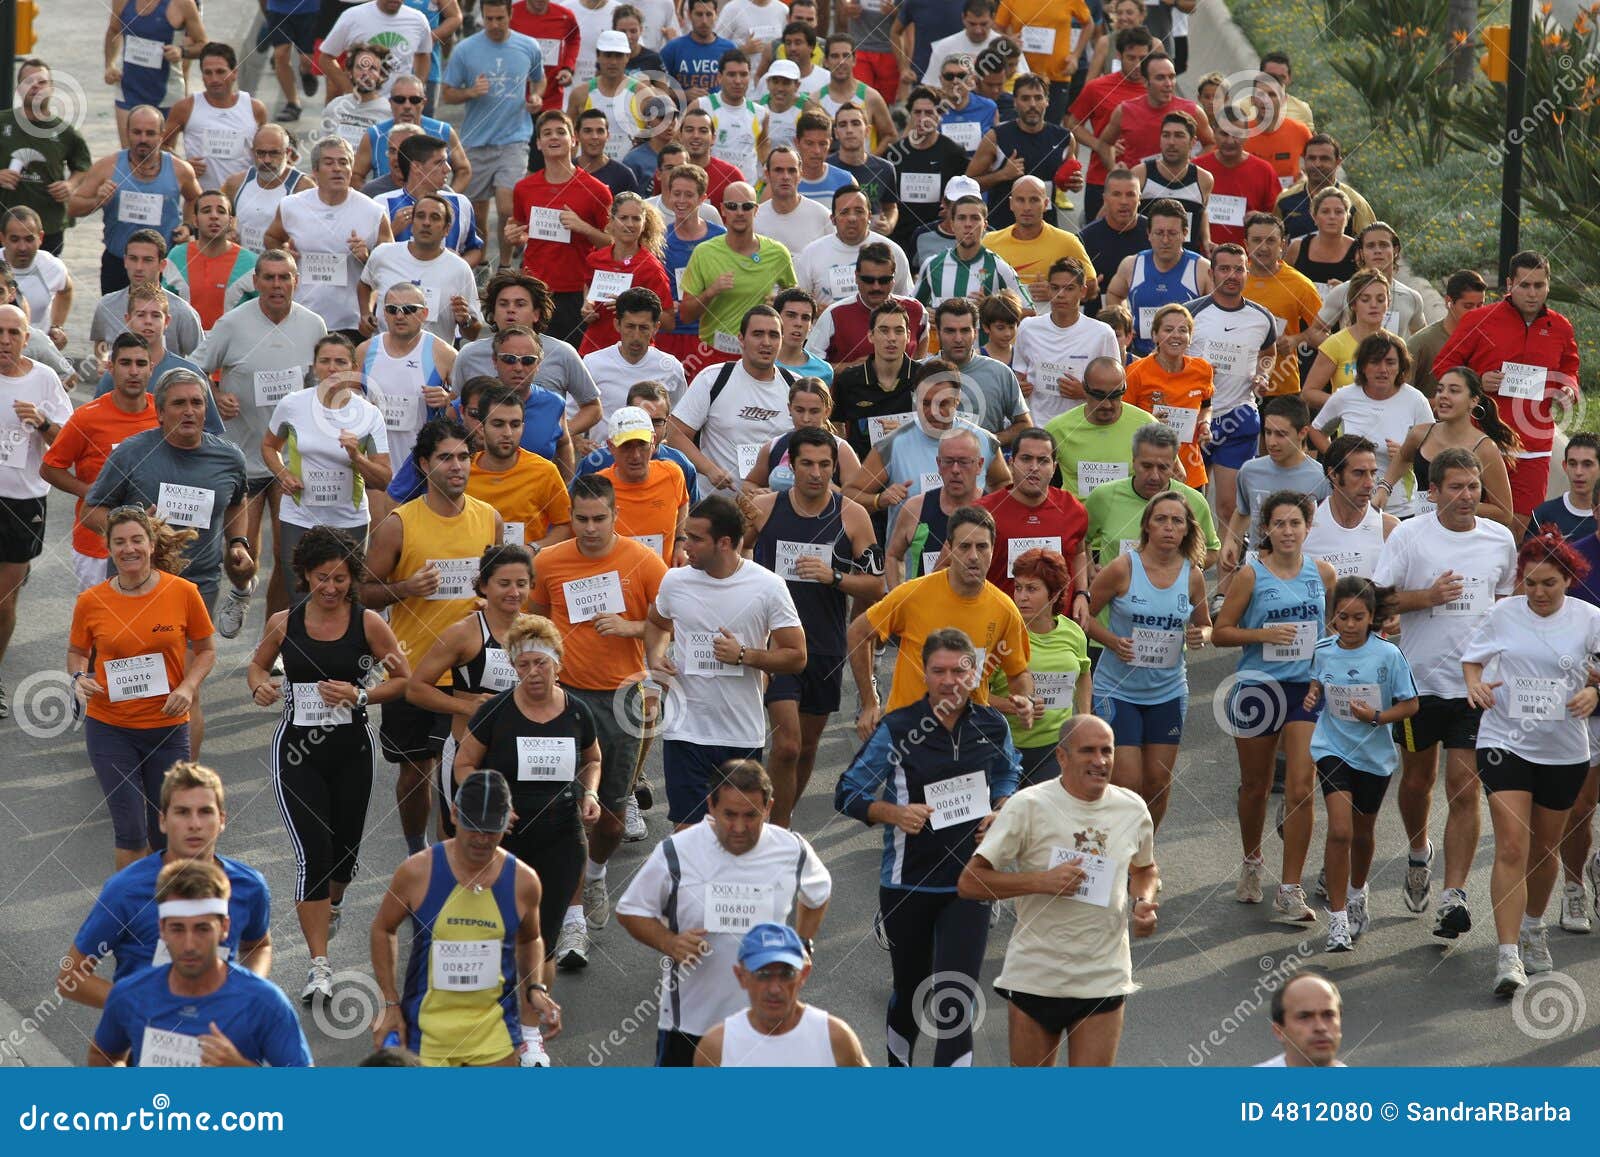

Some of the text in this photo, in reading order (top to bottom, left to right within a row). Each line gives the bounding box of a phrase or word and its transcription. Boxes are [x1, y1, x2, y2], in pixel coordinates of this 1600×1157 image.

[679, 59, 689, 73] A
[165, 484, 182, 494] XXIX
[167, 500, 199, 511] 012180
[783, 543, 799, 552] XXIX
[570, 580, 588, 591] XXIX
[575, 592, 608, 605] 000751
[1267, 602, 1319, 620] nerja
[1132, 613, 1183, 630] nerja
[691, 633, 709, 643] XXIX
[110, 659, 129, 671] XXIX
[116, 673, 152, 686] 004916
[523, 738, 541, 748] XXIX
[527, 755, 561, 764] 008729
[930, 781, 950, 794] XXIX
[936, 793, 972, 810] 006819
[712, 884, 734, 894] XXIX
[715, 903, 756, 914] 006800
[447, 917, 498, 929] ESTEPONA
[442, 962, 484, 972] 008277
